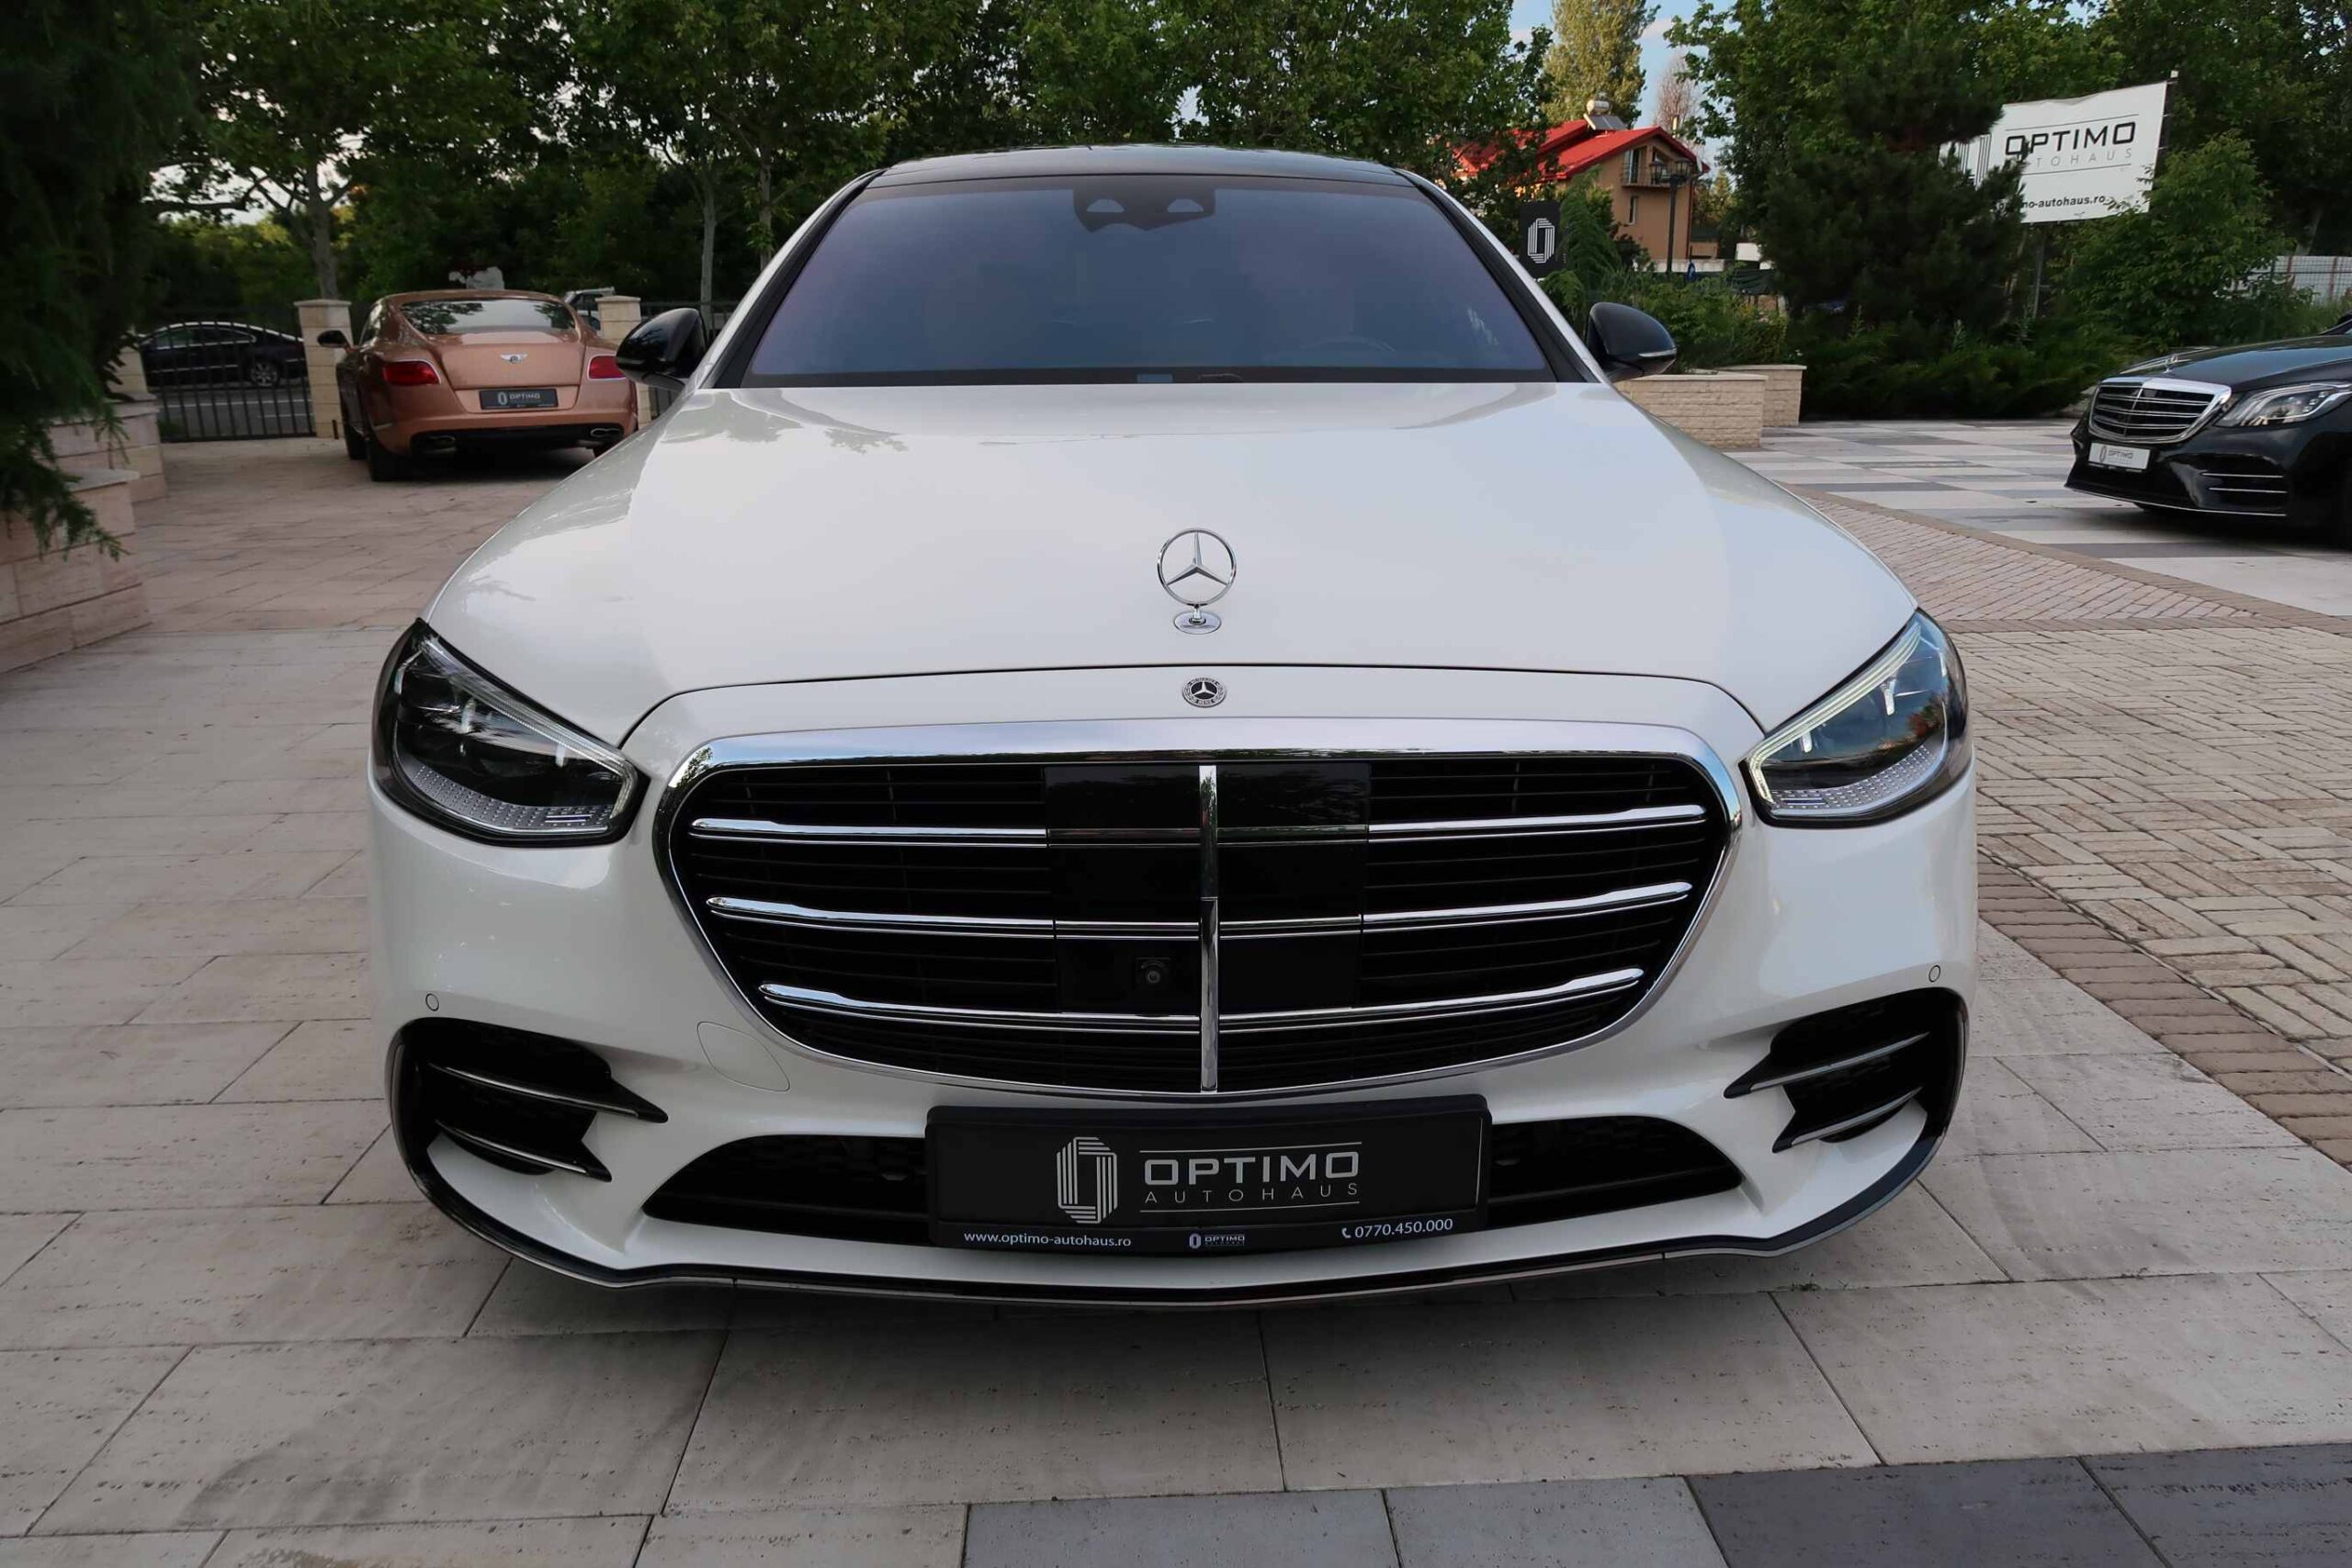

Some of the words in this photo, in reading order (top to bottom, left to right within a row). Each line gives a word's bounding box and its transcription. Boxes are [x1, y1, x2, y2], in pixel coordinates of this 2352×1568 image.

[2006, 122, 2136, 155] OPTIMO
[2034, 148, 2132, 167] TOHAUS
[1144, 1151, 1359, 1185] OPTIMO
[1145, 1182, 1358, 1203] AUTOHAUS
[964, 1233, 1132, 1247] www.optimo-autohaus.ro
[1204, 1235, 1245, 1243] OPTIMO
[1354, 1218, 1453, 1238] 0770.450.000
